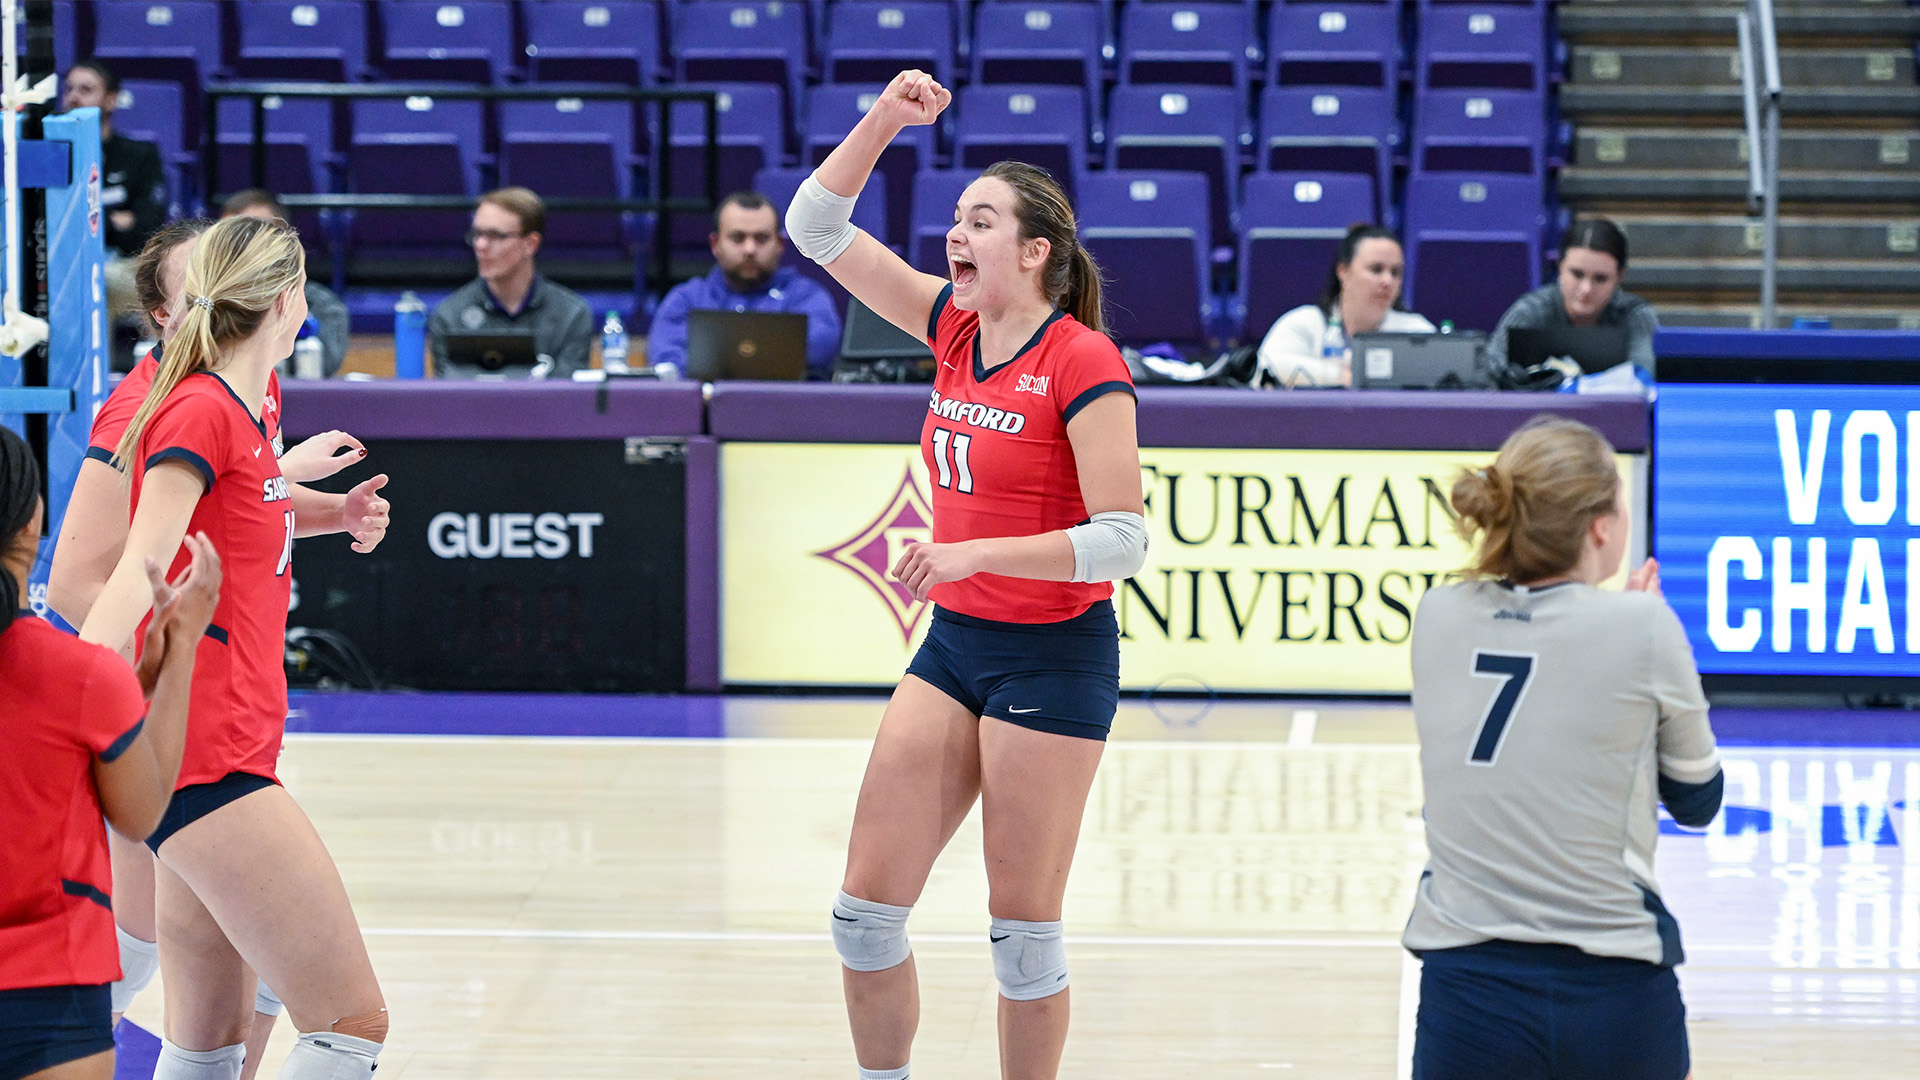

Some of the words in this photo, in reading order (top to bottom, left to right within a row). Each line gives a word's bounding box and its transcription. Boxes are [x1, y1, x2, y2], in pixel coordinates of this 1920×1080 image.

[931, 426, 974, 495] 11
[427, 511, 604, 559] GUEST
[1120, 569, 1465, 643] NIVERS
[1466, 649, 1538, 767] 7
